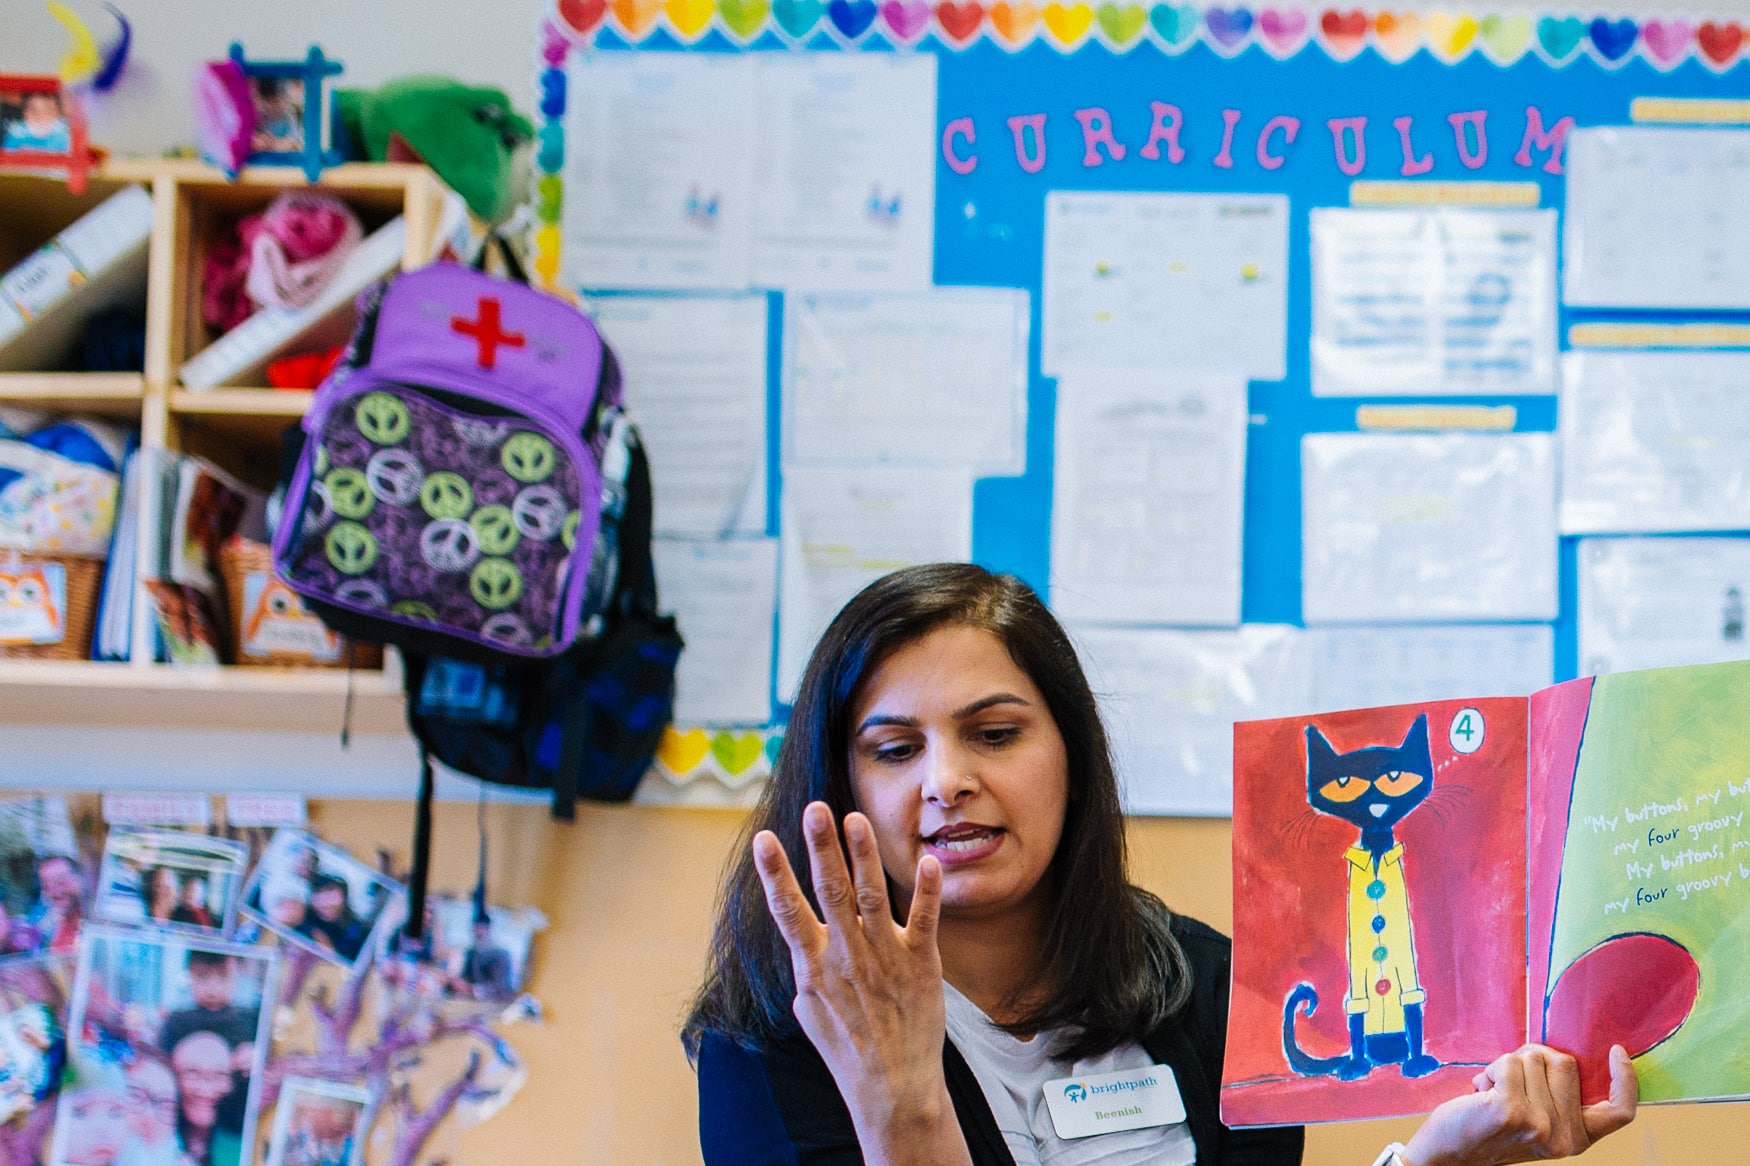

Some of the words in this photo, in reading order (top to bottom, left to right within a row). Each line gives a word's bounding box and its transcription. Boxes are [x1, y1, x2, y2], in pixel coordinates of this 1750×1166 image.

[942, 101, 1574, 176] CURRICULUM
[1455, 714, 1475, 742] 4
[1625, 797, 1688, 824] buttons,
[1696, 789, 1721, 807] my
[1614, 838, 1639, 856] my
[1648, 827, 1680, 847] four
[1688, 812, 1743, 841] groovy
[1626, 863, 1654, 881] My
[1660, 844, 1724, 871] buttons,
[1604, 898, 1629, 915] my
[1636, 887, 1668, 906] four
[1676, 871, 1732, 900] groovy
[1090, 1077, 1158, 1095] brightpath
[1094, 1105, 1143, 1120] Beenish
